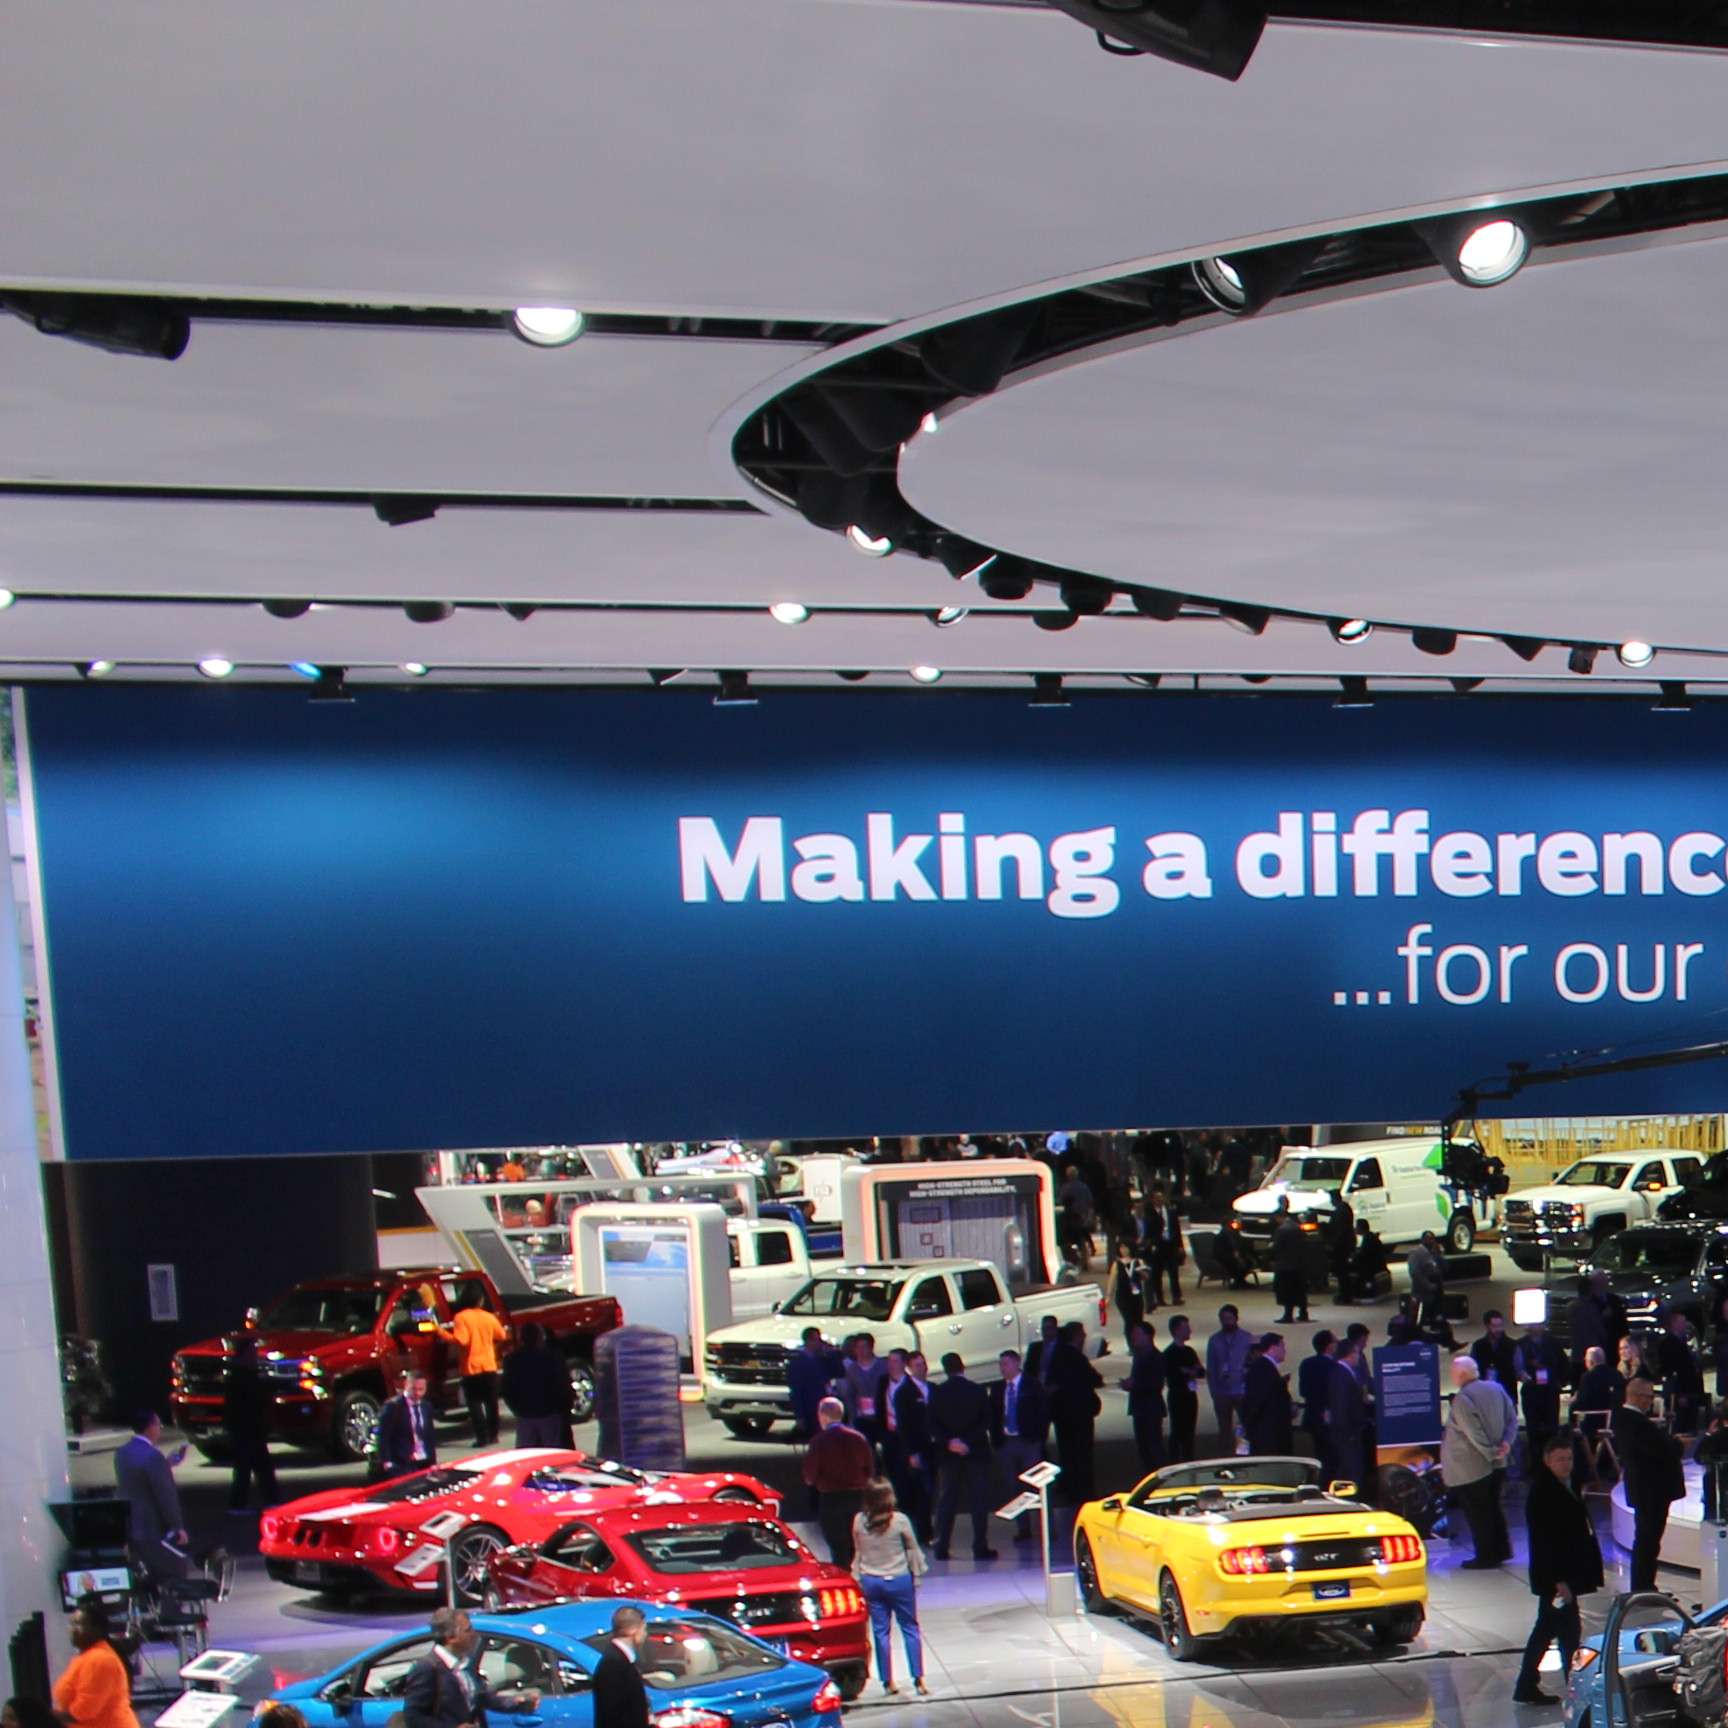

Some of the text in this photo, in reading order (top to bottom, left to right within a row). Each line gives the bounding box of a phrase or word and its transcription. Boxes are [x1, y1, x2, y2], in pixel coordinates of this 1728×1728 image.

[679, 813, 1119, 917] Making
[1143, 832, 1211, 898] a
[1555, 943, 1703, 1002] our
